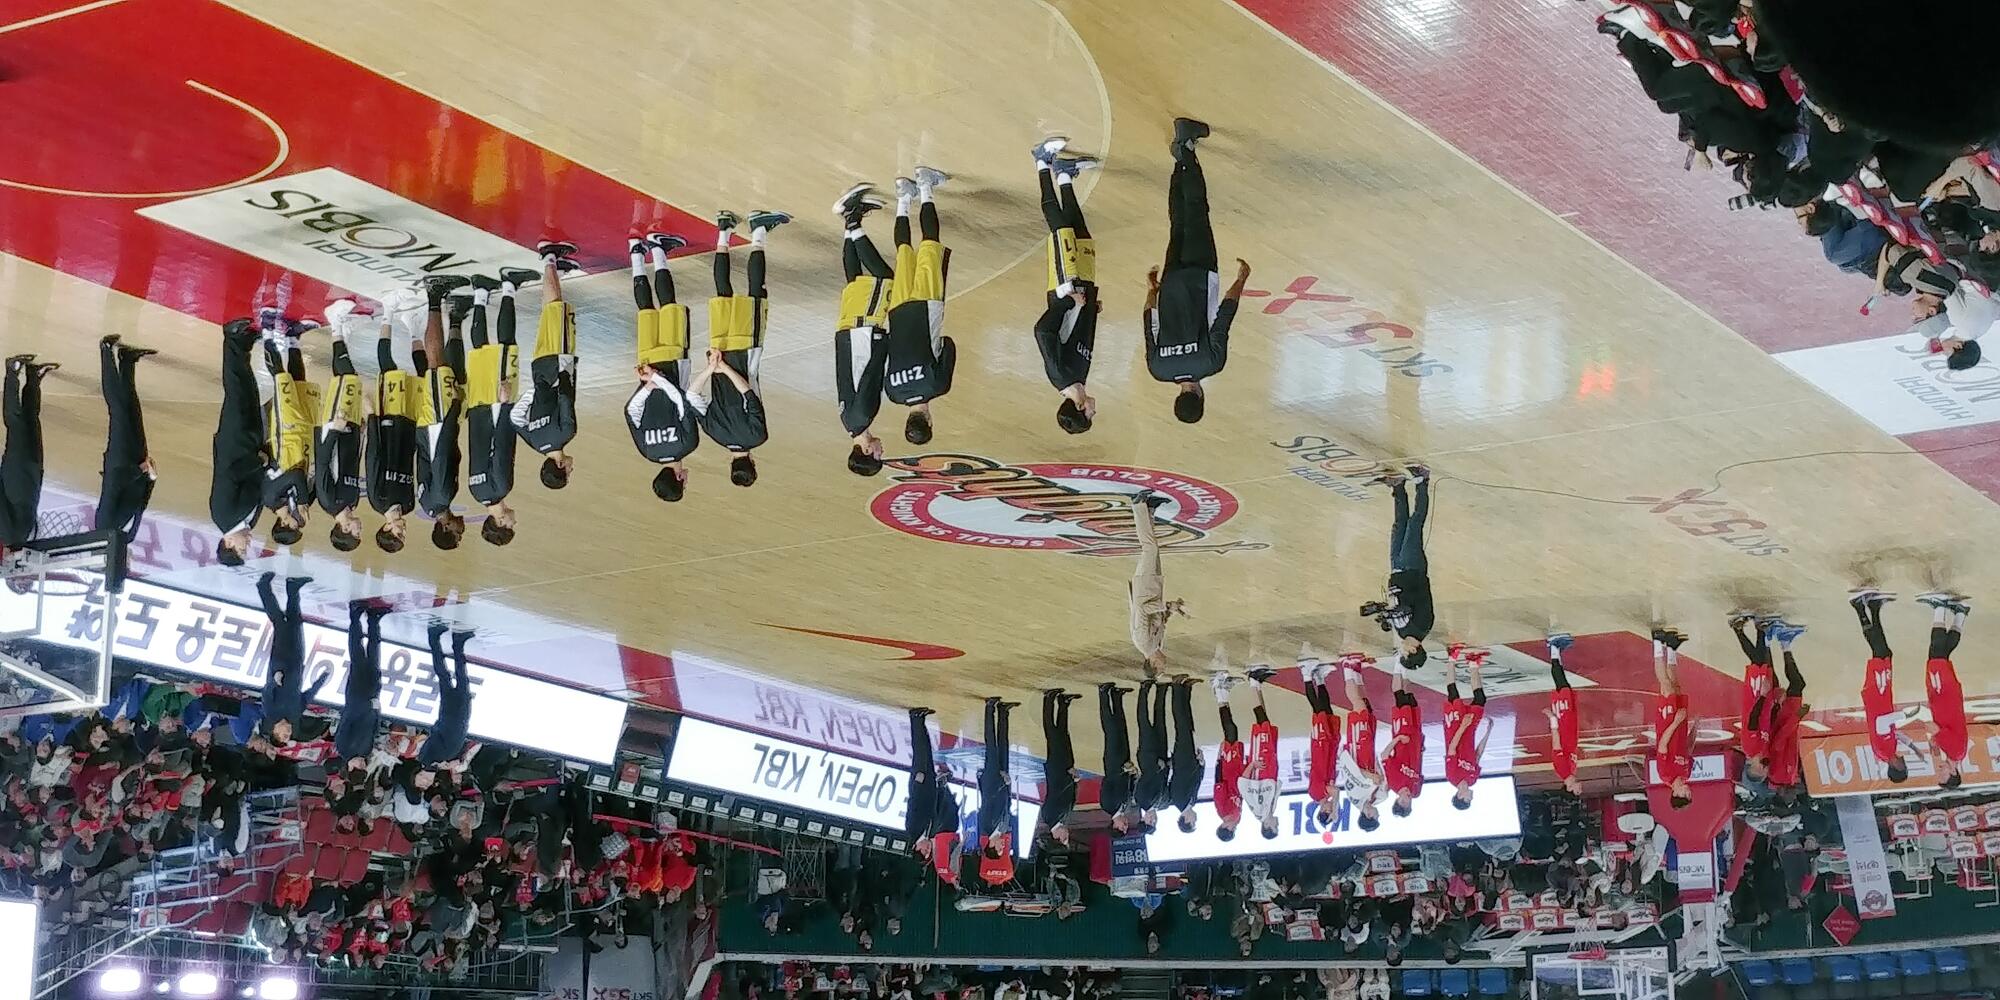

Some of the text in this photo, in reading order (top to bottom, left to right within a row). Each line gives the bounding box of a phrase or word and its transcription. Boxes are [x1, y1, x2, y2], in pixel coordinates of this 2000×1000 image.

[243, 190, 480, 273] MOBIS
[302, 239, 423, 293] YUNDAI
[1184, 342, 1198, 353] LG
[1359, 346, 1453, 377] SKT
[281, 381, 291, 394] 2
[346, 384, 355, 396] 3
[388, 380, 405, 393] 14
[1892, 376, 1975, 421] HYUNDAI
[1069, 467, 1222, 524] BASKETBALL CLUB
[889, 490, 1045, 547] SEOUL SK KNIGHTS
[1718, 534, 1789, 557] SKT
[752, 742, 810, 793] KBL
[818, 751, 897, 814] OPEN,
[1289, 797, 1349, 836] KBL
